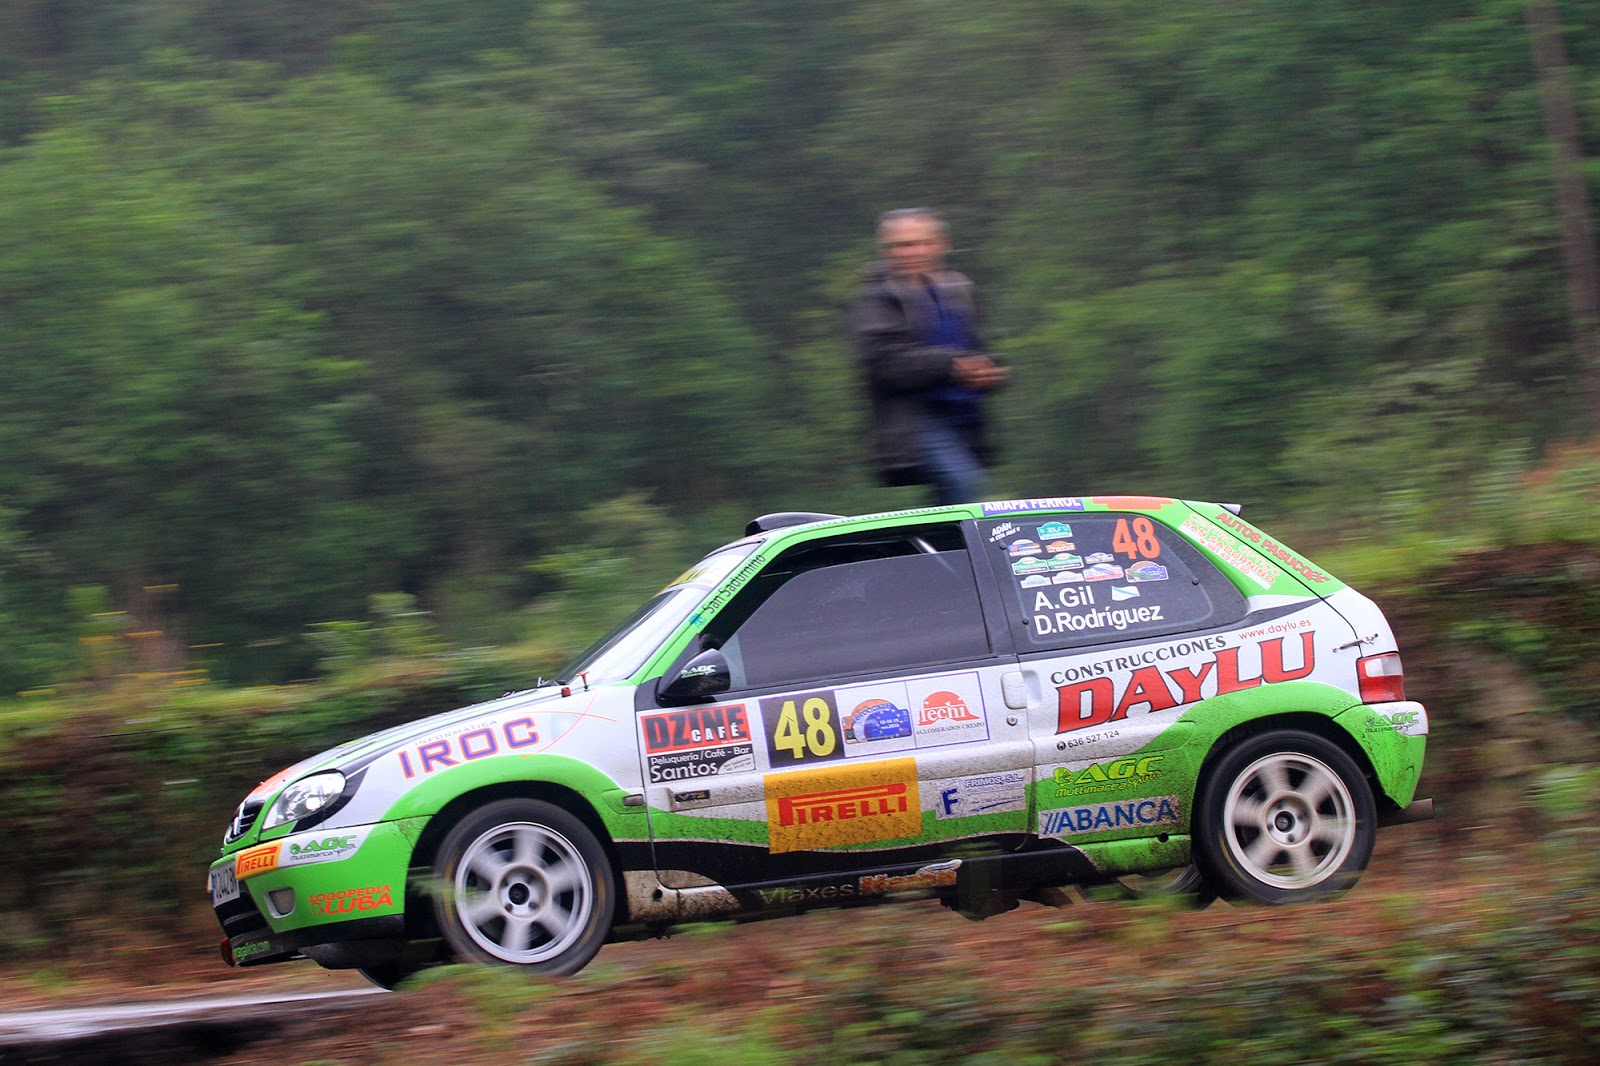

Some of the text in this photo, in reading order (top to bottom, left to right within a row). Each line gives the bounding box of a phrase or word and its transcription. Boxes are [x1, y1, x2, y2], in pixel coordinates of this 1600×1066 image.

[984, 499, 1030, 512] AMAPA
[1112, 516, 1161, 560] 48
[1184, 519, 1208, 538] SAN
[1188, 513, 1237, 546] CENTRO
[1215, 512, 1263, 544] AUTOS
[701, 595, 726, 614] San
[1034, 585, 1095, 611] A.Gil
[1034, 604, 1165, 635] D.Rodríguez
[1238, 618, 1312, 641] www.daylu.es
[1050, 635, 1227, 685] CONSTRUCCIONES
[1054, 630, 1316, 735] DAYLU
[645, 706, 747, 749] DZINE
[773, 697, 836, 759] 48
[961, 722, 985, 731] CRESPO
[1372, 711, 1419, 727] AGC
[691, 722, 740, 743] CAFÉ
[1067, 730, 1120, 748] 636 527 124
[398, 716, 540, 779] IROC
[733, 746, 751, 755] Bar
[650, 761, 718, 782] Santos
[1074, 755, 1165, 784] AGC
[777, 782, 907, 827] PIRELLI
[300, 834, 357, 853] AGC
[237, 845, 278, 875] PIRELLI
[309, 884, 391, 903] LOGOPEDIA
[325, 892, 393, 915] LUBA
